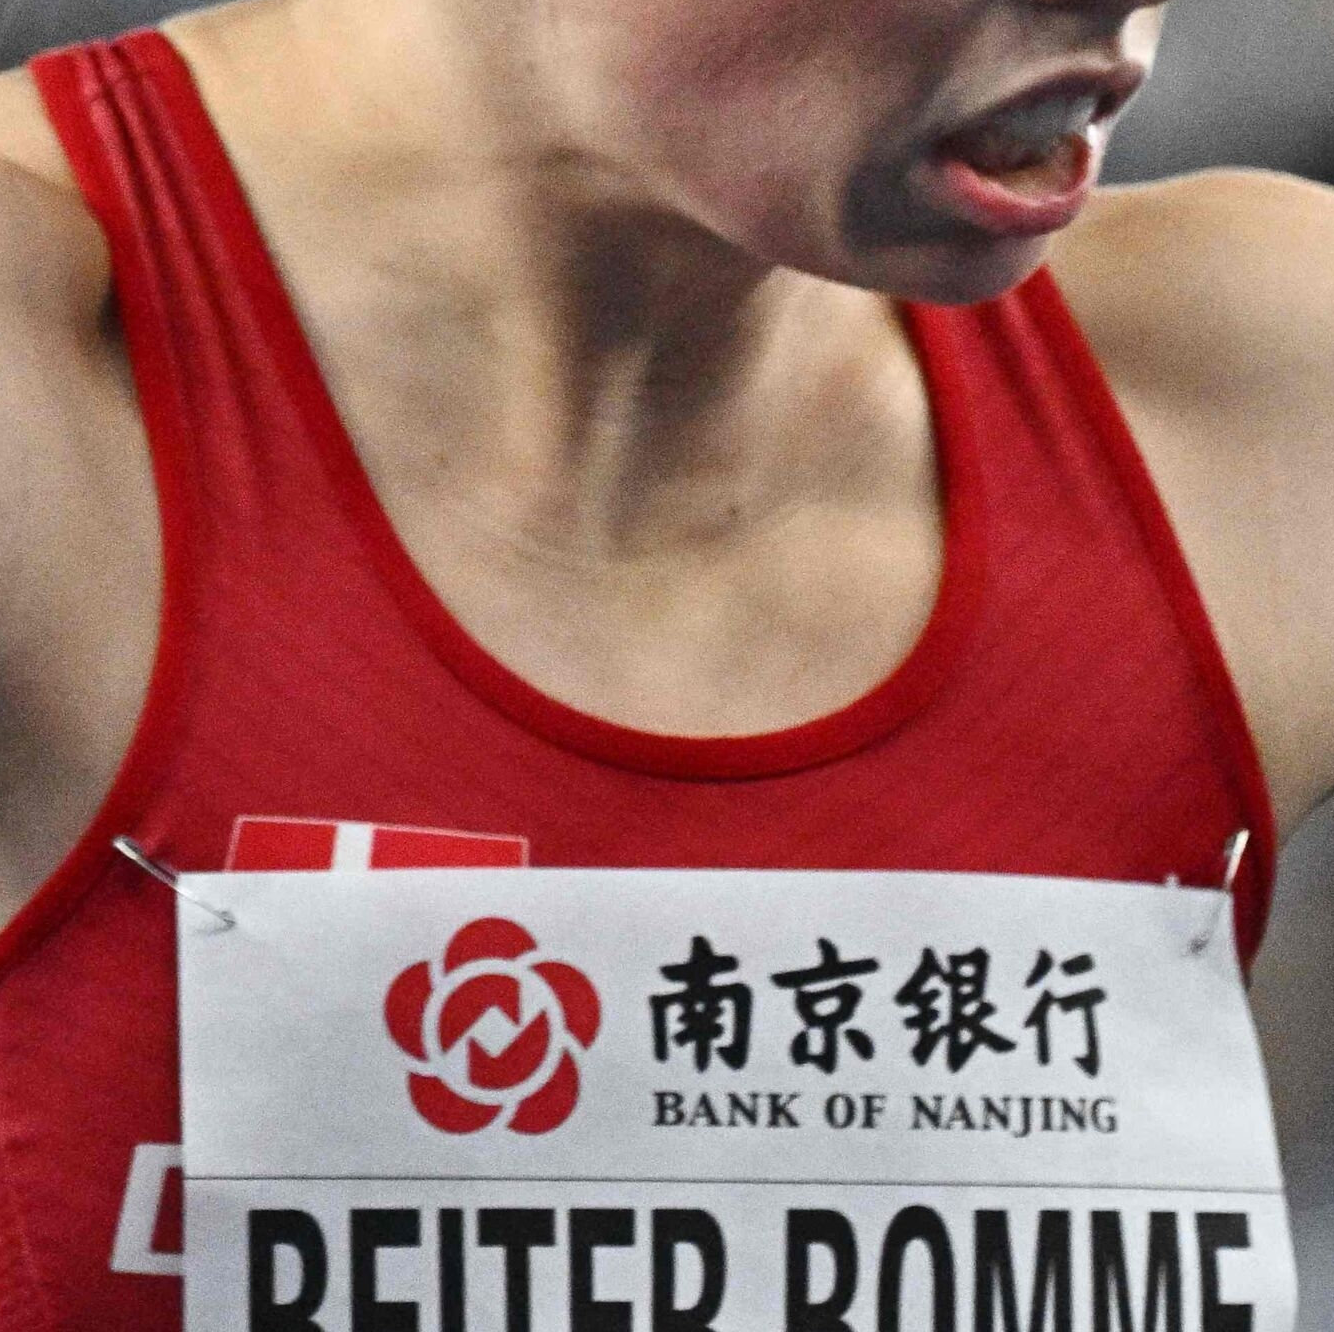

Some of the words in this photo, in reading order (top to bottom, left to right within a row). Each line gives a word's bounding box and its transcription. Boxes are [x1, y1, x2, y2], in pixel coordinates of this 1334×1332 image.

[647, 934, 1108, 1078] 南京银行
[651, 1091, 803, 1129] BANK
[823, 1092, 887, 1131] OF
[911, 1094, 1119, 1139] NANJING
